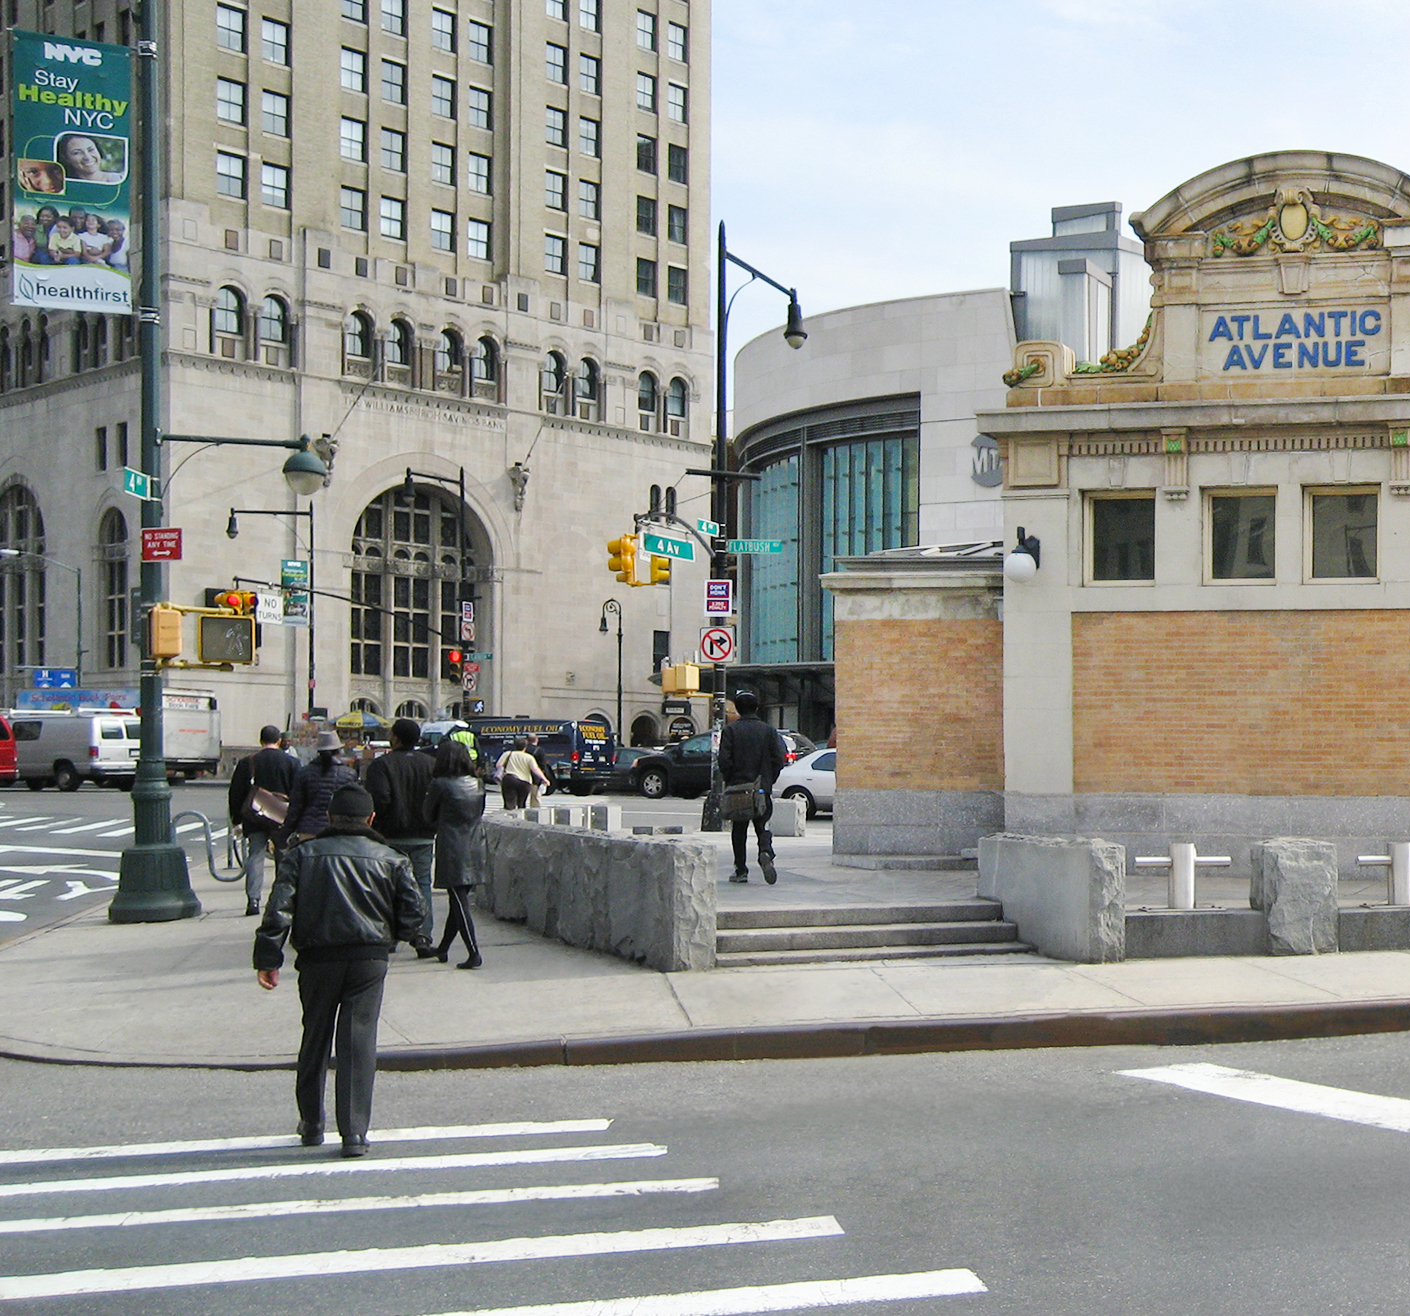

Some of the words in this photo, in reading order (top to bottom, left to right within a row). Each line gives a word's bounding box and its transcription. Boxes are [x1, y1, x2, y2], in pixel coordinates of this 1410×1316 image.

[44, 42, 102, 66] NYC
[34, 69, 78, 92] Stay
[19, 83, 128, 116] Healthy
[64, 108, 114, 129] NYC
[36, 281, 128, 303] healthfirst
[1209, 310, 1381, 342] ATLANTIC
[1223, 340, 1365, 371] AVENUE
[443, 412, 480, 427] SAVINGS
[129, 473, 136, 492] 4
[701, 522, 707, 532] 4
[154, 532, 179, 540] STANDING
[147, 541, 160, 549] ANY
[163, 540, 177, 548] TIME
[657, 541, 664, 552] 4
[728, 543, 770, 552] FLATBUSH
[264, 598, 277, 609] NO
[258, 611, 282, 622] TURNS
[481, 725, 520, 733] ECONOMY
[523, 725, 544, 733] FUEL
